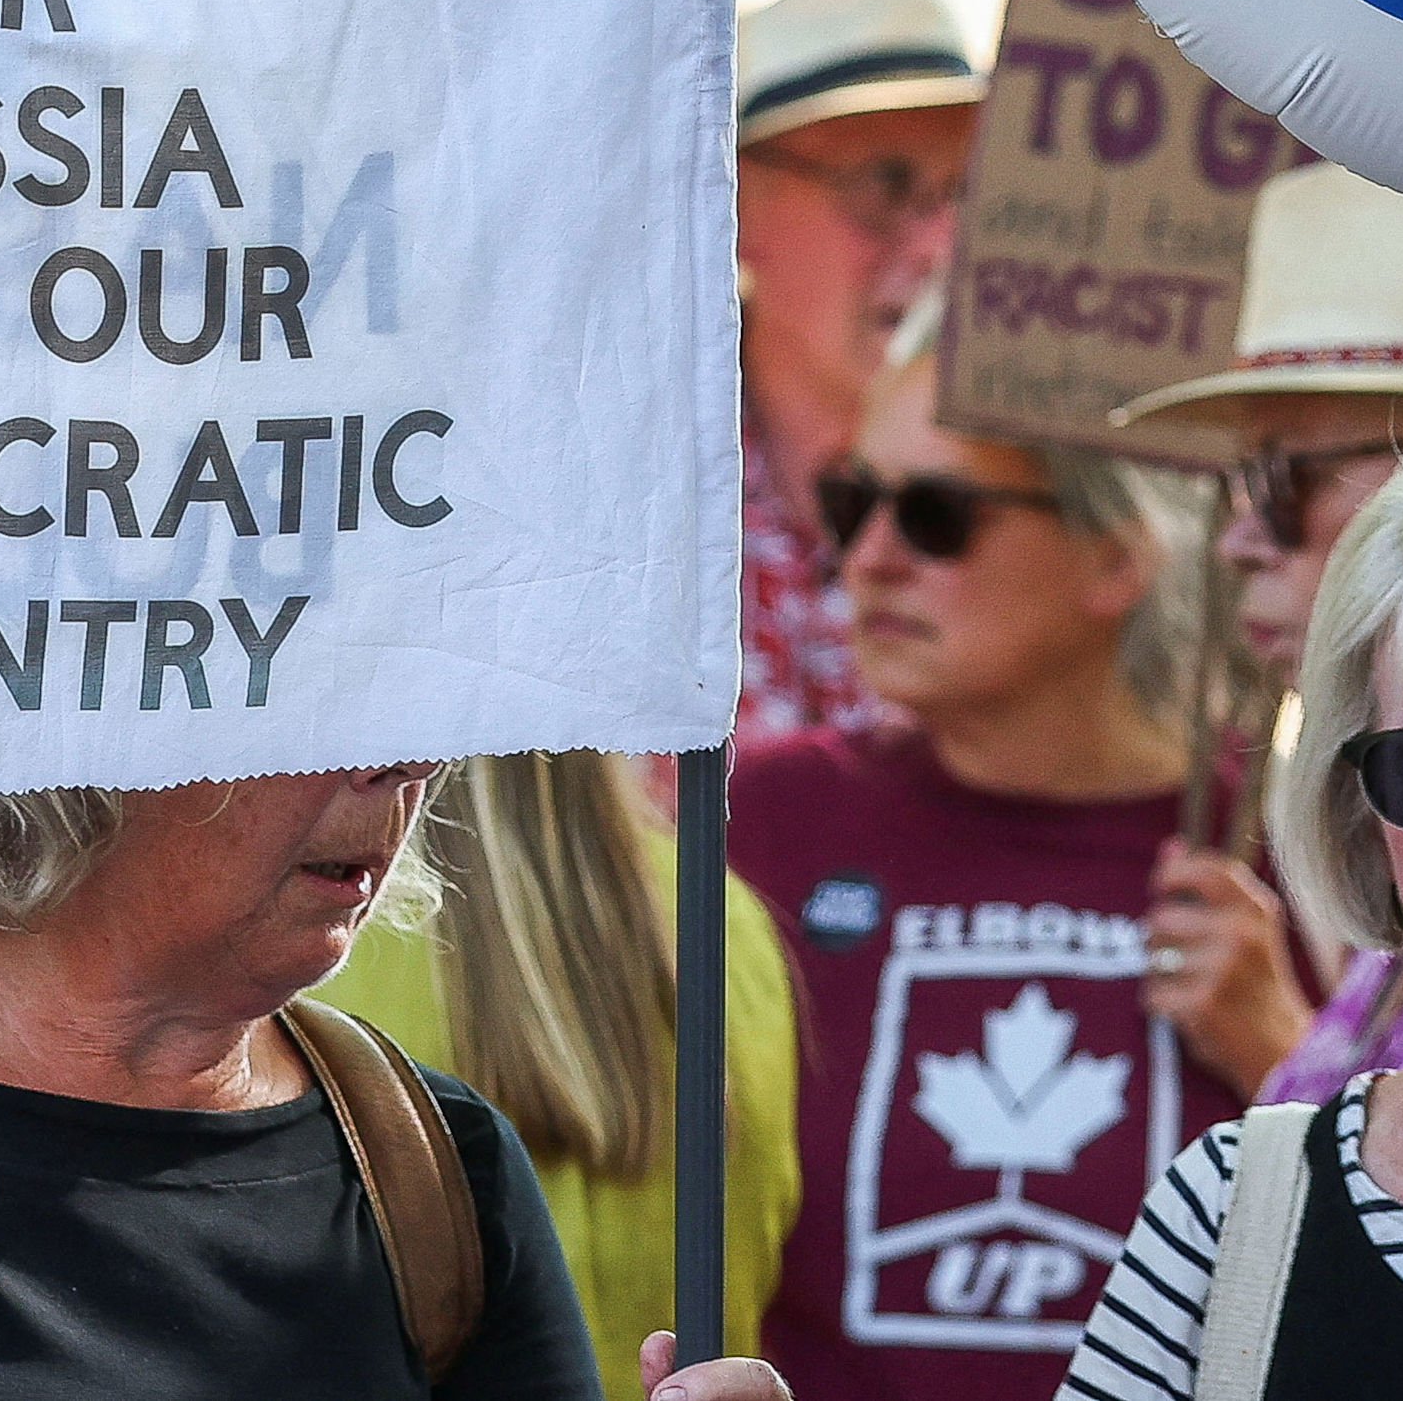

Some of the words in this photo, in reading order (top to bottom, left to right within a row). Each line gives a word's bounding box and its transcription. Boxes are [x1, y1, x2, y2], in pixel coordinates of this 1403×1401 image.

[1004, 35, 1165, 165] TO
[1196, 86, 1325, 192] G
[29, 246, 313, 366] OUR
[974, 256, 1230, 356] RACIST
[894, 901, 1149, 952] ELBOW
[926, 1239, 1087, 1316] UP
